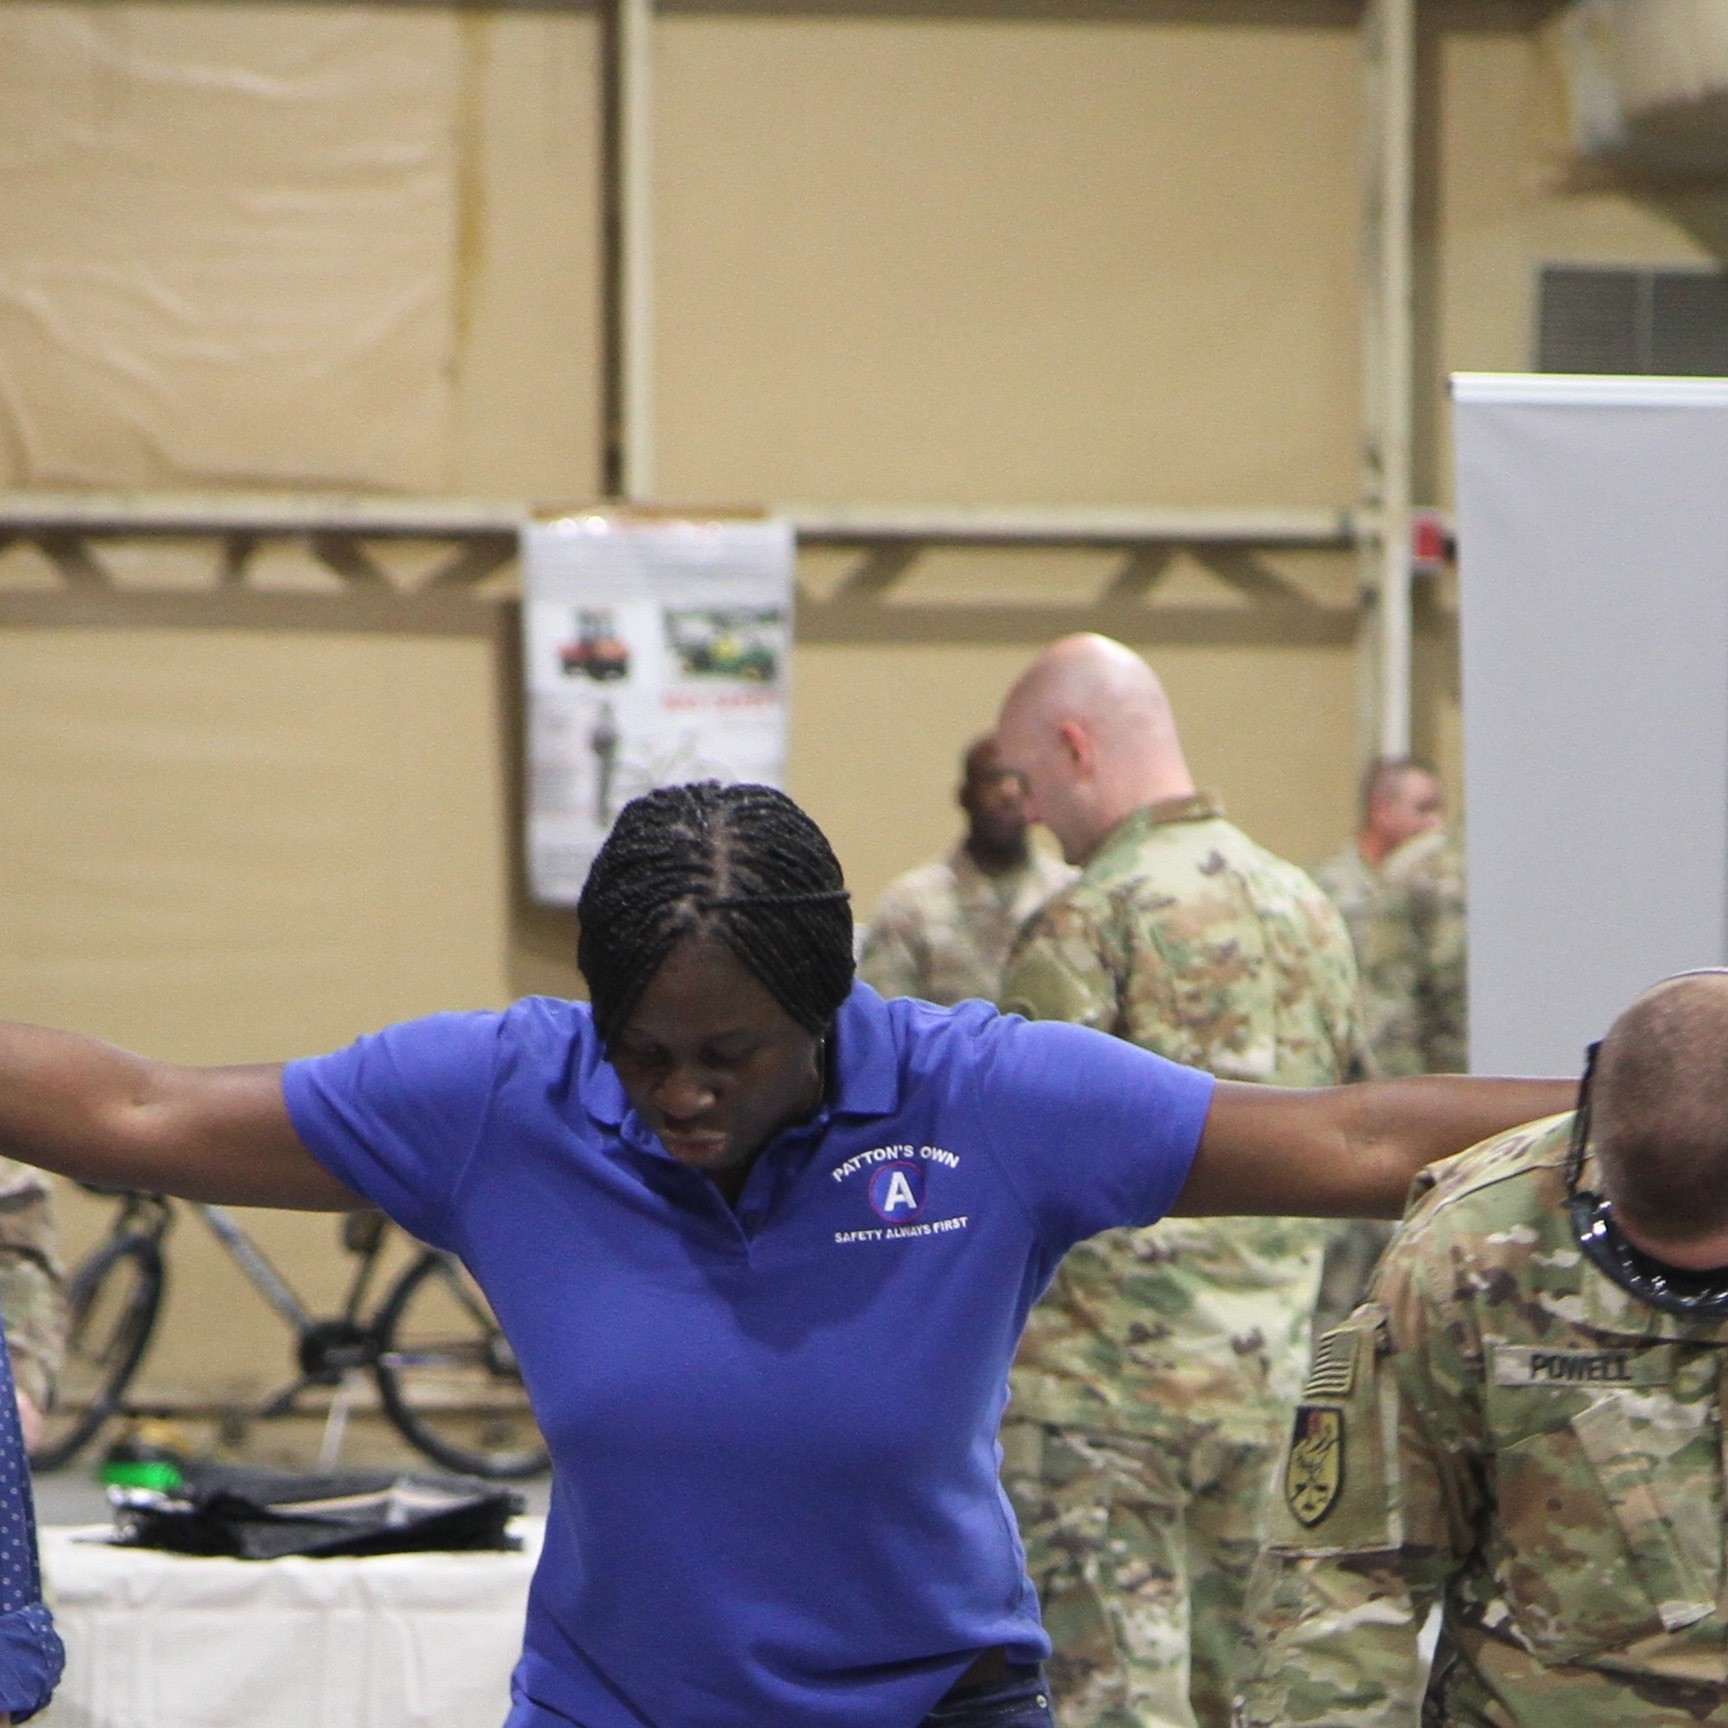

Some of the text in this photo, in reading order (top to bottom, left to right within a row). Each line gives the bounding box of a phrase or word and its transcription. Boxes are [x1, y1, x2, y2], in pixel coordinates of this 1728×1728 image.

[831, 1144, 961, 1182] PATTON'S OWN
[883, 1170, 918, 1212] A
[833, 1216, 969, 1244] SAFETY ALWAYS FIRST
[1529, 1352, 1633, 1381] POWELL
